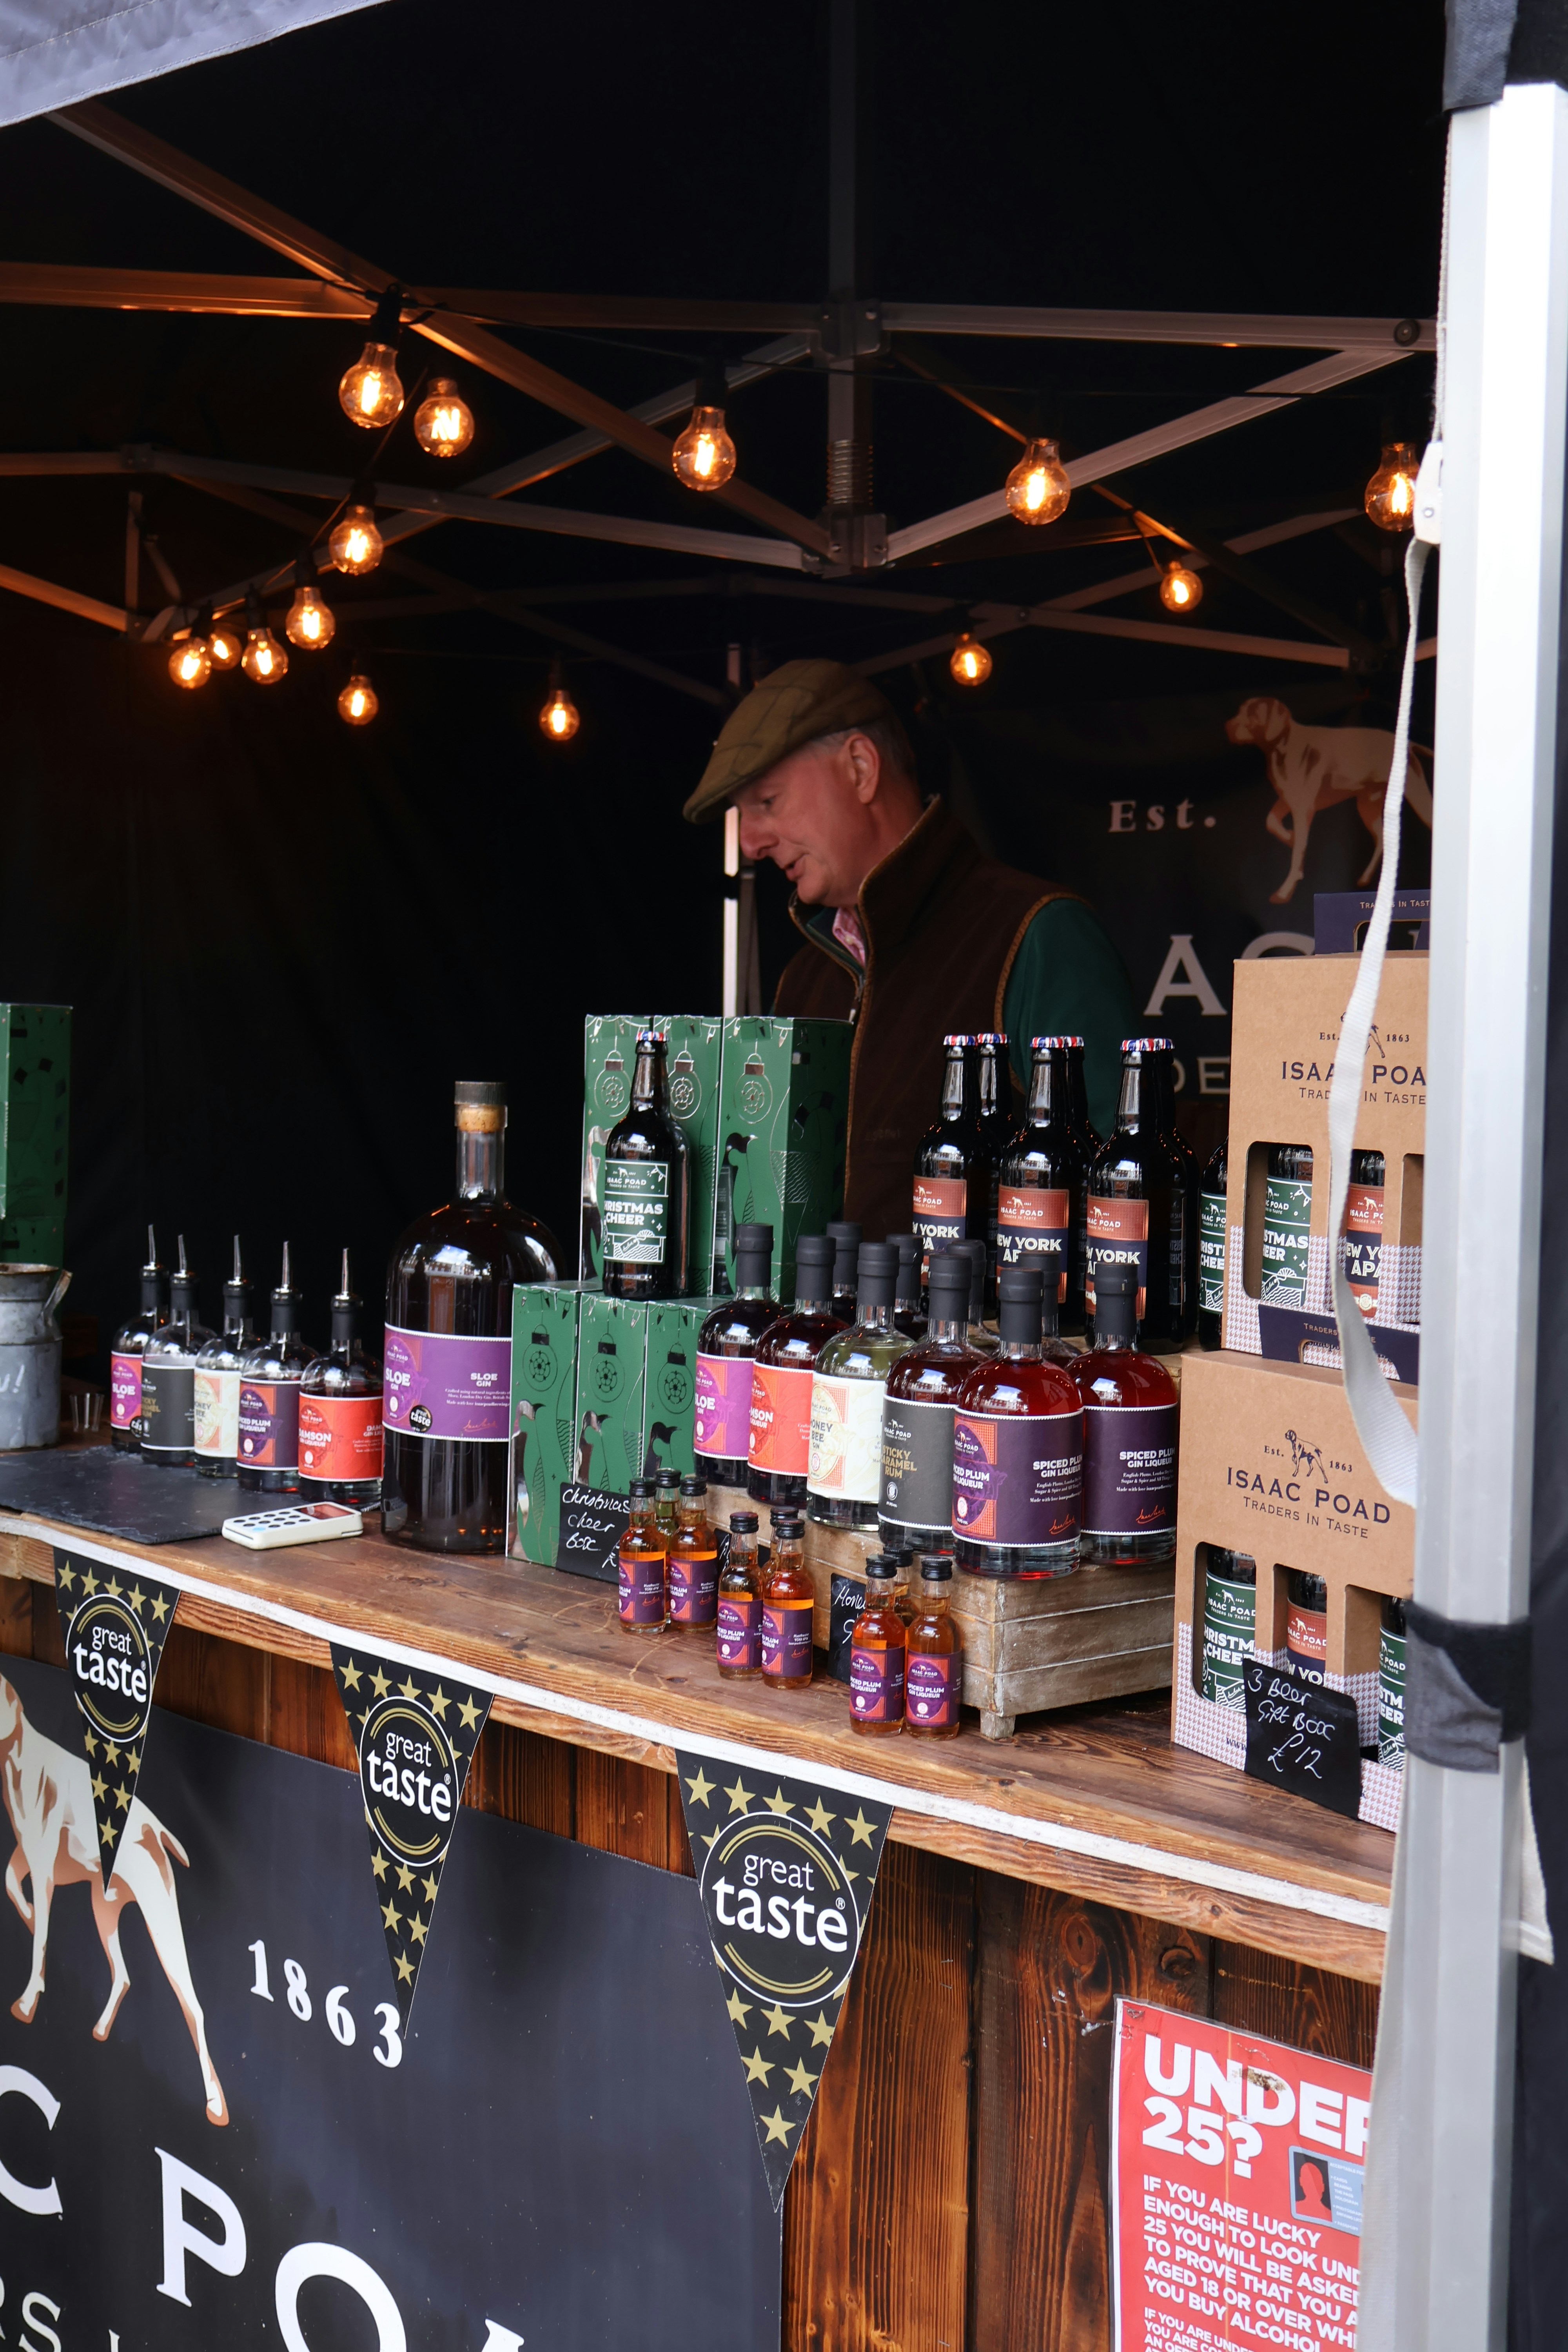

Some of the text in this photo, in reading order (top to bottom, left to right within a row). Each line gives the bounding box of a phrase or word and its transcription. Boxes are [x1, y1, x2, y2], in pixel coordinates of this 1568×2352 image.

[1109, 798, 1216, 832] Est.
[1319, 1032, 1410, 1042] Est. 1863
[1282, 1062, 1426, 1085] ISAA POA
[1364, 1091, 1426, 1105] IN TASTE
[1270, 1201, 1289, 1210] POAD
[606, 1212, 644, 1225] CHEER
[1350, 1209, 1369, 1218] ISAAC
[920, 1224, 960, 1238] YORK
[1015, 1237, 1062, 1251] YORK
[1095, 1248, 1141, 1265] YORK
[1303, 1322, 1338, 1336] TRADERS
[385, 1367, 410, 1387] SLOE
[470, 1372, 498, 1381] SLOE
[251, 1418, 271, 1427] PLUM
[410, 1411, 431, 1427] taste
[811, 1432, 824, 1442] BEE
[896, 1430, 911, 1438] POAD
[964, 1443, 978, 1452] POAD
[1120, 1447, 1175, 1460] SPICED PLUM
[1033, 1459, 1068, 1470] SPICED
[1145, 1457, 1172, 1467] LIQUEUR
[1264, 1445, 1352, 1473] Est. 1863
[885, 1466, 902, 1479] RUM
[965, 1469, 990, 1481] PLUM
[1041, 1470, 1056, 1478] GIN
[957, 1478, 984, 1489] LIQUEUR
[1227, 1467, 1390, 1524] ISAAC POAD
[1243, 1496, 1368, 1538] TRADERS IN TASTE
[1208, 1597, 1227, 1611] ISAAC
[1211, 1606, 1226, 1616] TRADERS
[92, 1625, 132, 1656] great
[765, 1636, 779, 1644] PLUM
[1385, 1657, 1406, 1671] POAD
[73, 1642, 148, 1704] taste
[1248, 1669, 1312, 1706] 3 Beer
[386, 1732, 432, 1768] great
[366, 1749, 451, 1822] taste
[743, 1854, 815, 1891] great
[711, 1876, 848, 1953] taste
[248, 1939, 403, 2068] 1863
[1143, 2095, 1263, 2180] 25?
[1144, 2174, 1321, 2249] IF YOU ARE LUCKY
[1144, 2194, 1361, 2286] ENOUGH TO LOOK UND
[1144, 2216, 1167, 2235] 25
[1171, 2223, 1210, 2251] YOU
[1214, 2239, 1261, 2274] WILL
[1266, 2260, 1292, 2283] BE
[1144, 2235, 1341, 2321] TO PROVE THAT YOU
[1144, 2256, 1311, 2333] AGED 18 OR OVER
[1144, 2275, 1184, 2303] YOU
[1189, 2292, 1227, 2321] BUY
[1145, 2307, 1212, 2343] IF YOU ARE
[1144, 2334, 1162, 2349] AN
[1145, 2319, 1170, 2339] YOU
[1173, 2332, 1198, 2350] ARE
